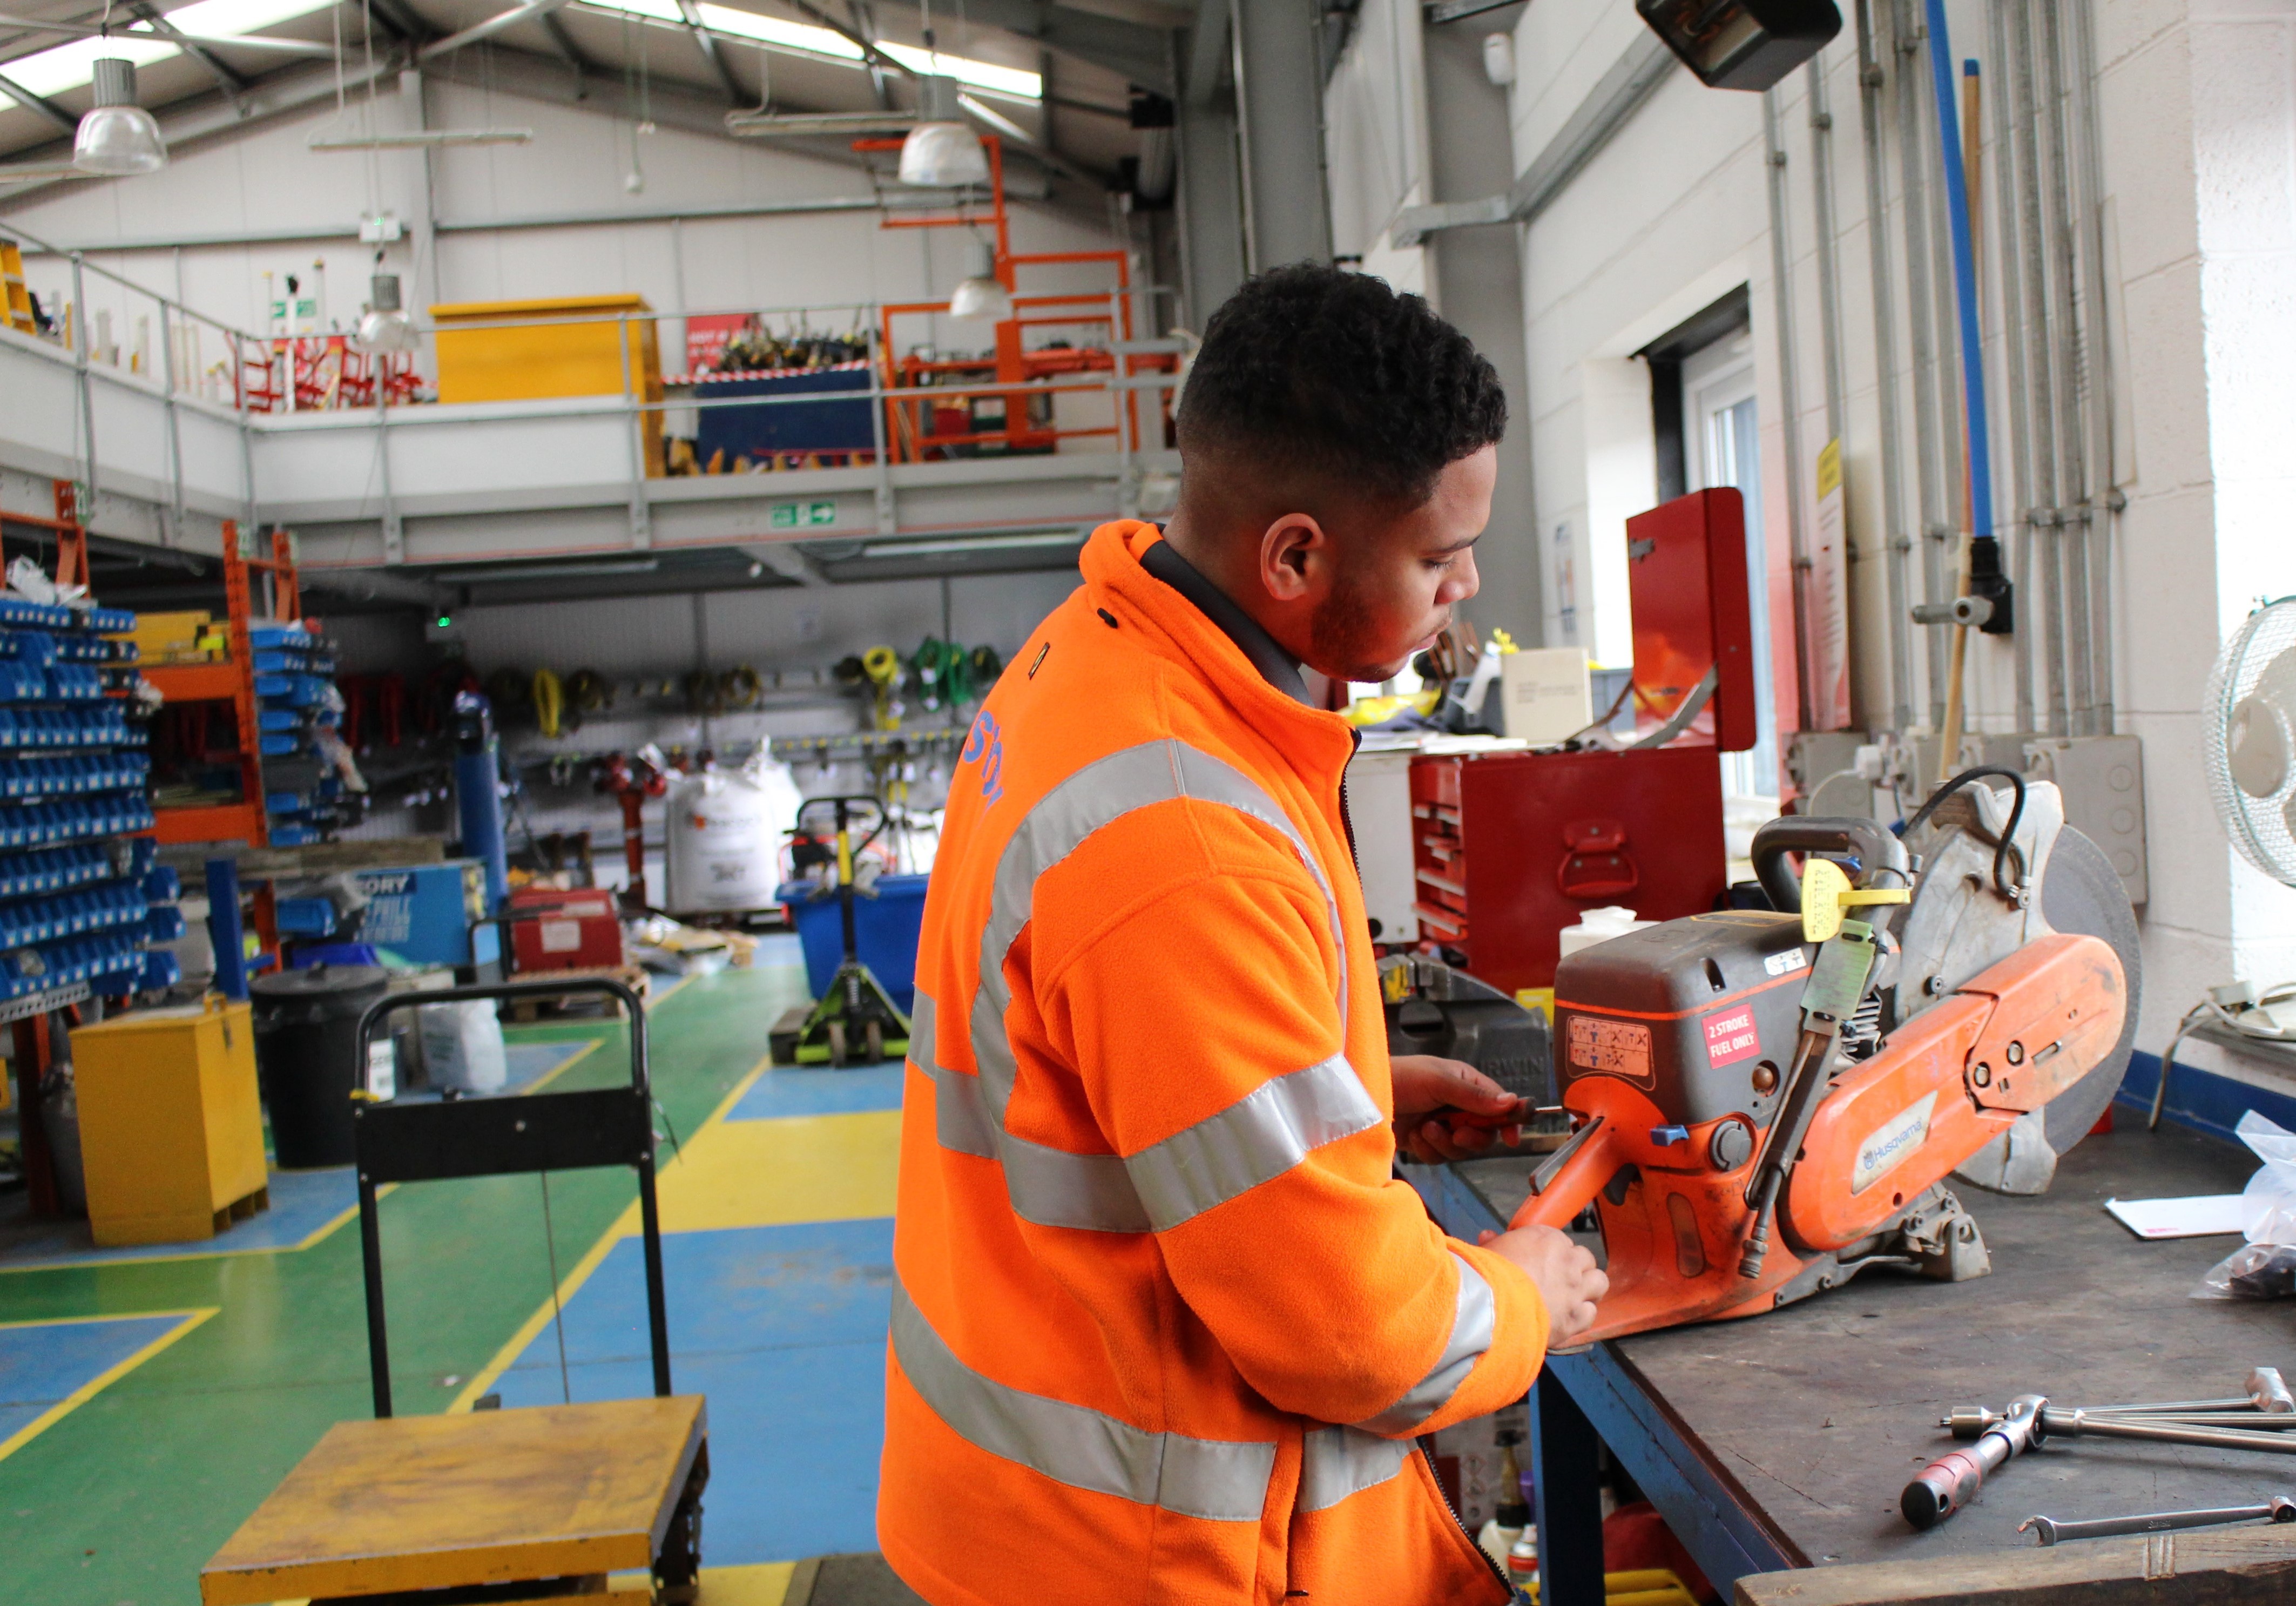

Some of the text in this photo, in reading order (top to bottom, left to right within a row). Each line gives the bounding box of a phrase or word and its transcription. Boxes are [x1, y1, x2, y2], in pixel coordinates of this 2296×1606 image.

[1709, 1014, 1750, 1038] 2 STROKE
[1710, 1032, 1754, 1057] FUEL ONLY
[1874, 1121, 1922, 1160] Husqvarna
